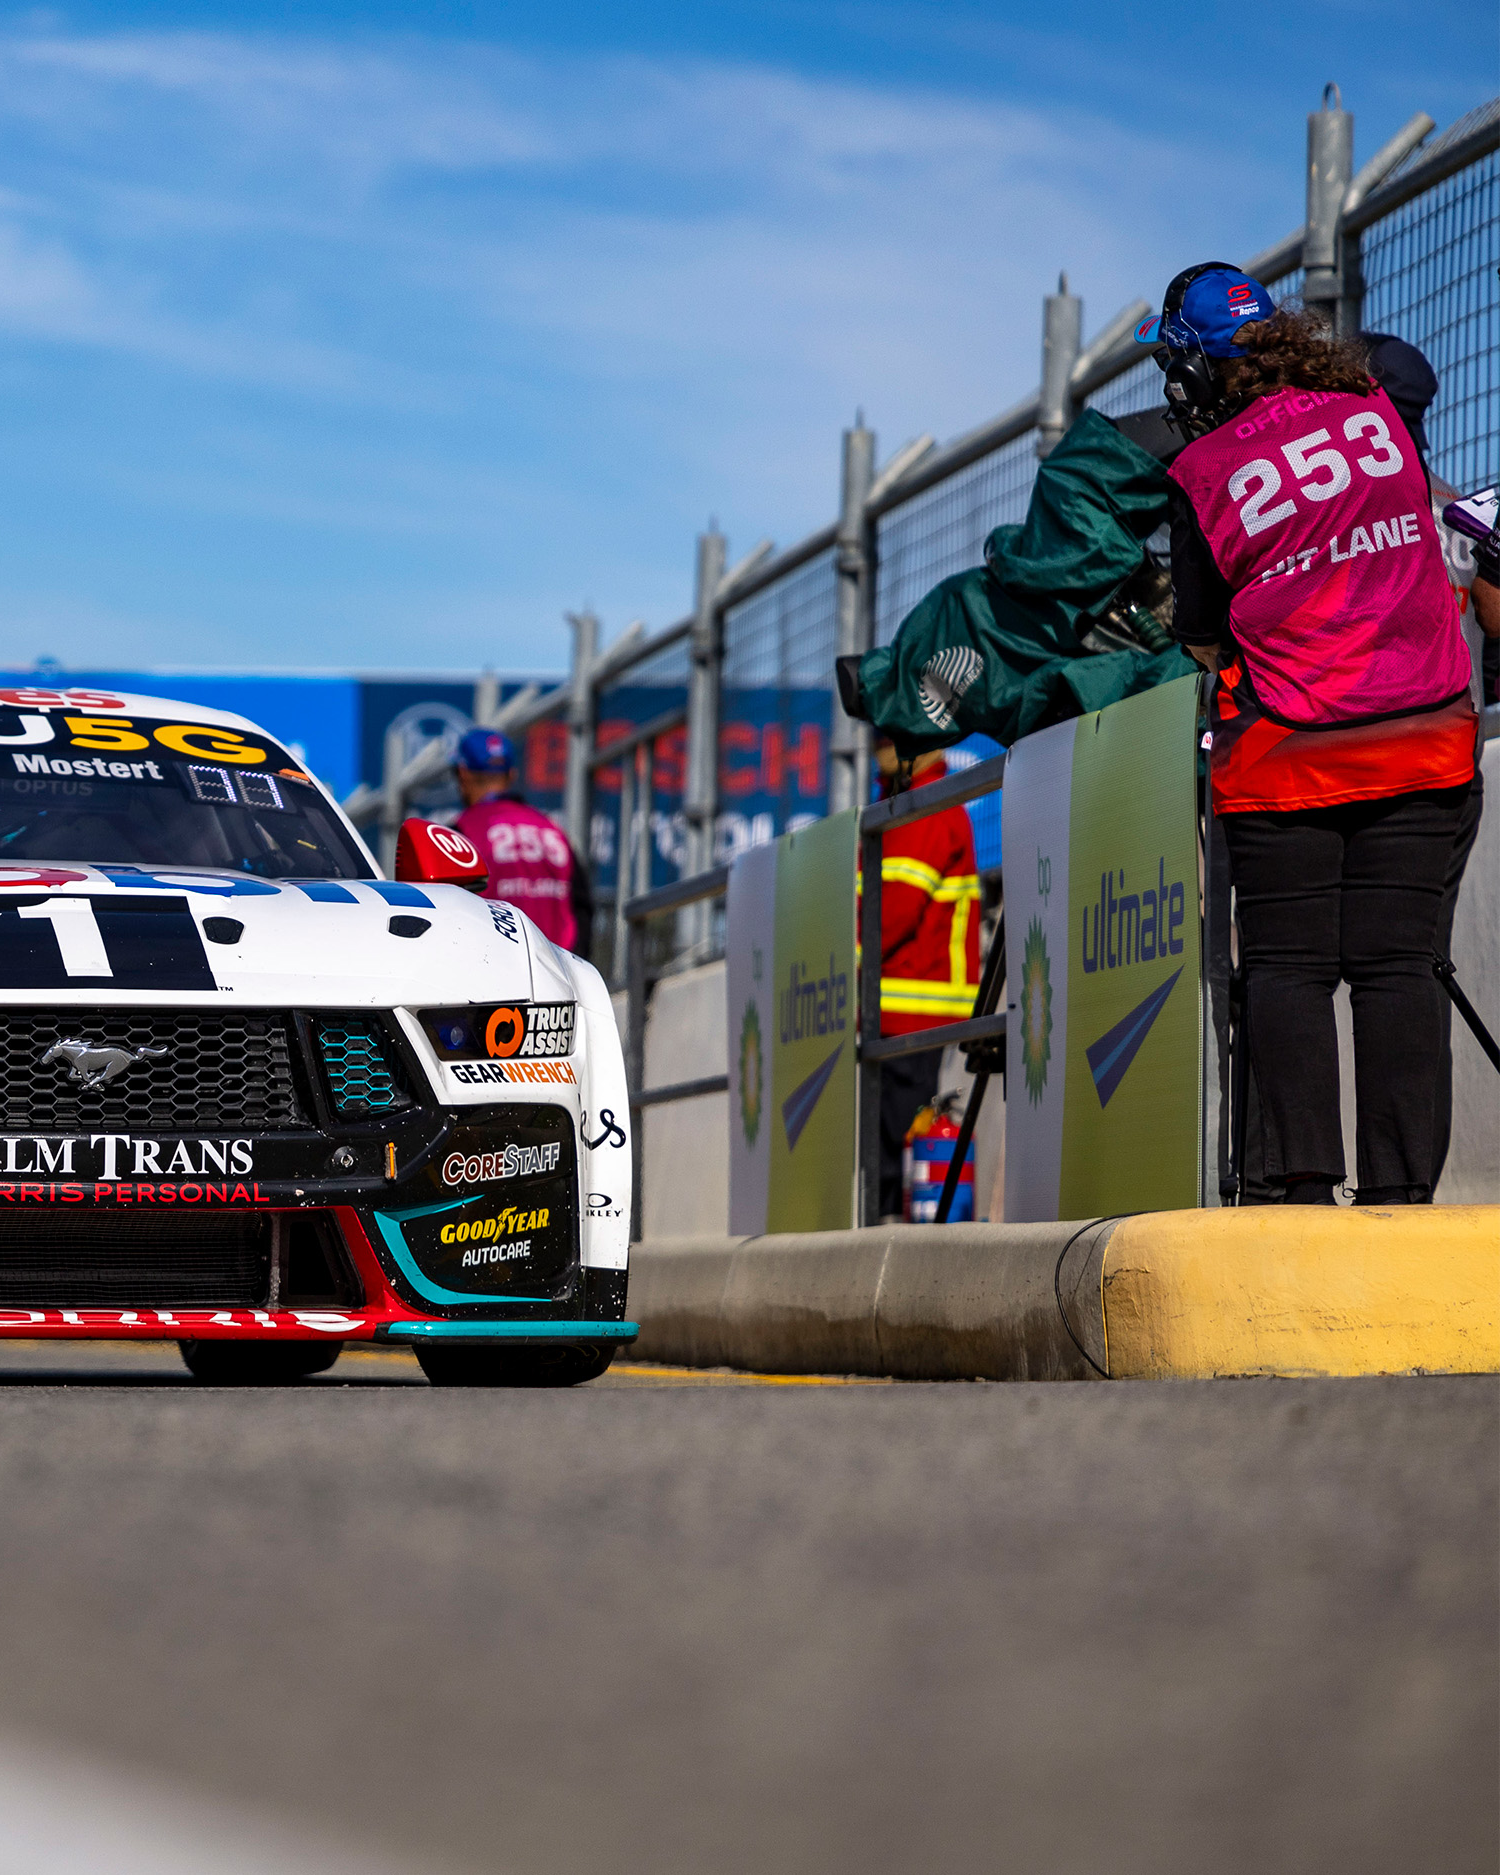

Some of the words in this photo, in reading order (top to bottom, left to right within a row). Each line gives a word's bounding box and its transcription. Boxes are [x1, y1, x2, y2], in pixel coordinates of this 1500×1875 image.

[1227, 410, 1404, 538] 253
[1328, 512, 1422, 564] LANE
[11, 752, 164, 781] Mostert
[1083, 855, 1185, 974] ultimate
[16, 897, 114, 978] 1
[779, 950, 848, 1044] ultimate
[526, 1005, 574, 1031] TRUCK
[518, 1030, 574, 1056] ASSIST
[450, 1060, 578, 1085] GEARWRENCH
[90, 1133, 256, 1181] TRANS
[94, 1181, 271, 1203] PERSONAL
[440, 1206, 551, 1245] GOODYEAR
[586, 1209, 622, 1218] KLEY
[462, 1238, 532, 1268] AUTOCARE
